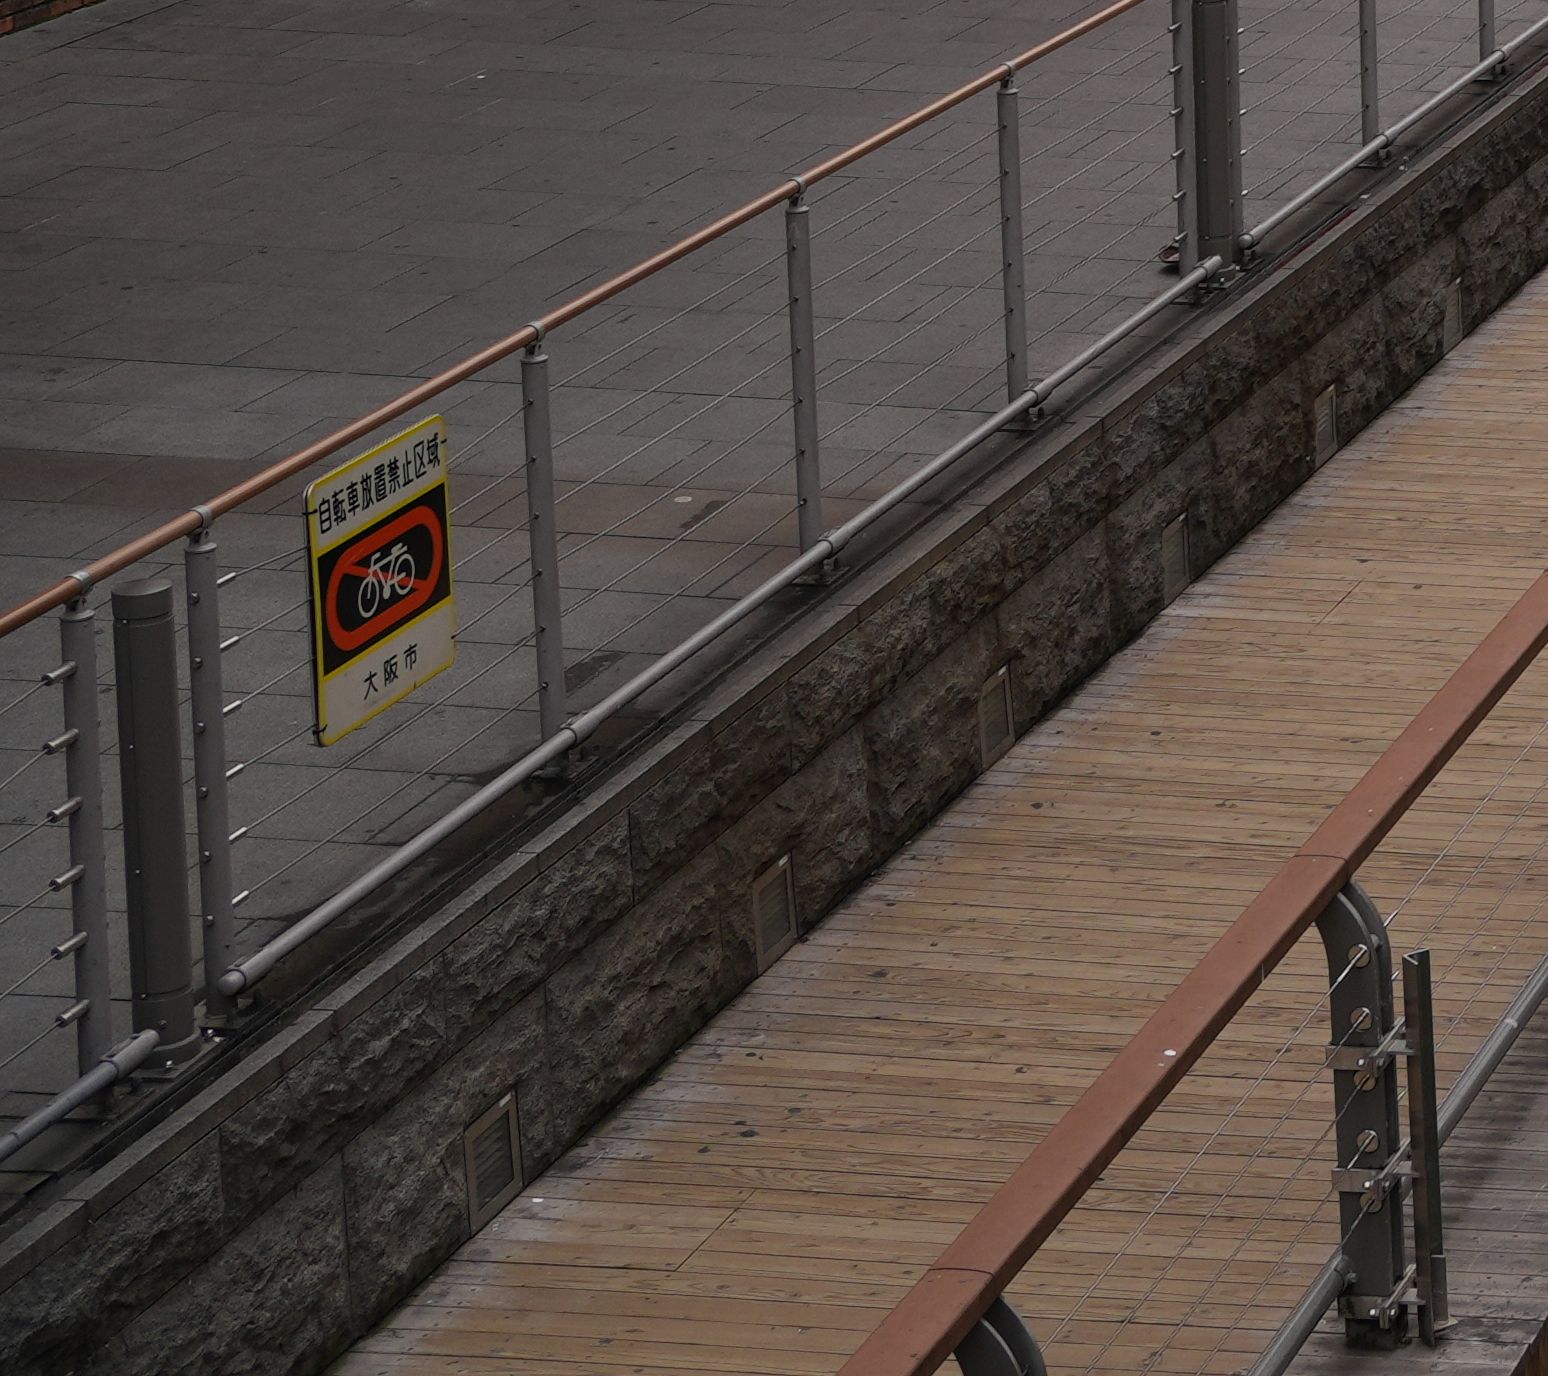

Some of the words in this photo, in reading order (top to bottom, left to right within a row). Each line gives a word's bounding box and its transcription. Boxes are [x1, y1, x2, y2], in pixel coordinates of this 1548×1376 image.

[318, 432, 441, 536] 自転車放置禁止区域
